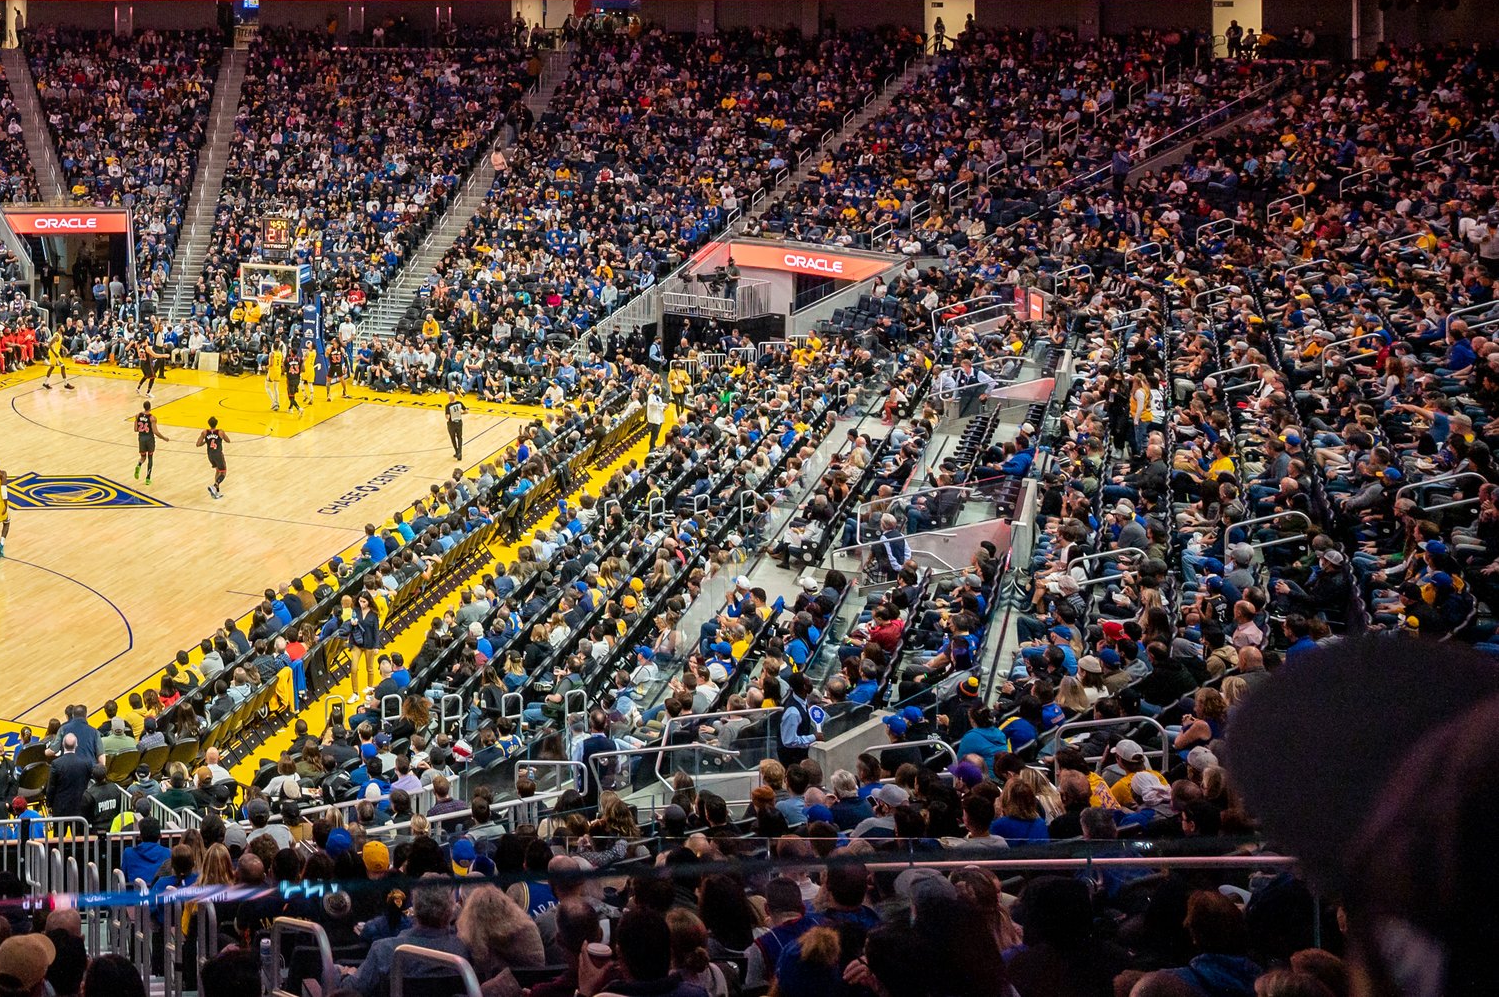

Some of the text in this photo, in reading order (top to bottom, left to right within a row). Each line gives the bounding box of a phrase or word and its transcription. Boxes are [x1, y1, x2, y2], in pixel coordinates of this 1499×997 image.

[34, 217, 97, 230] ORACLE
[784, 254, 843, 274] ORACLE
[317, 464, 411, 515] CHASE CENTER
